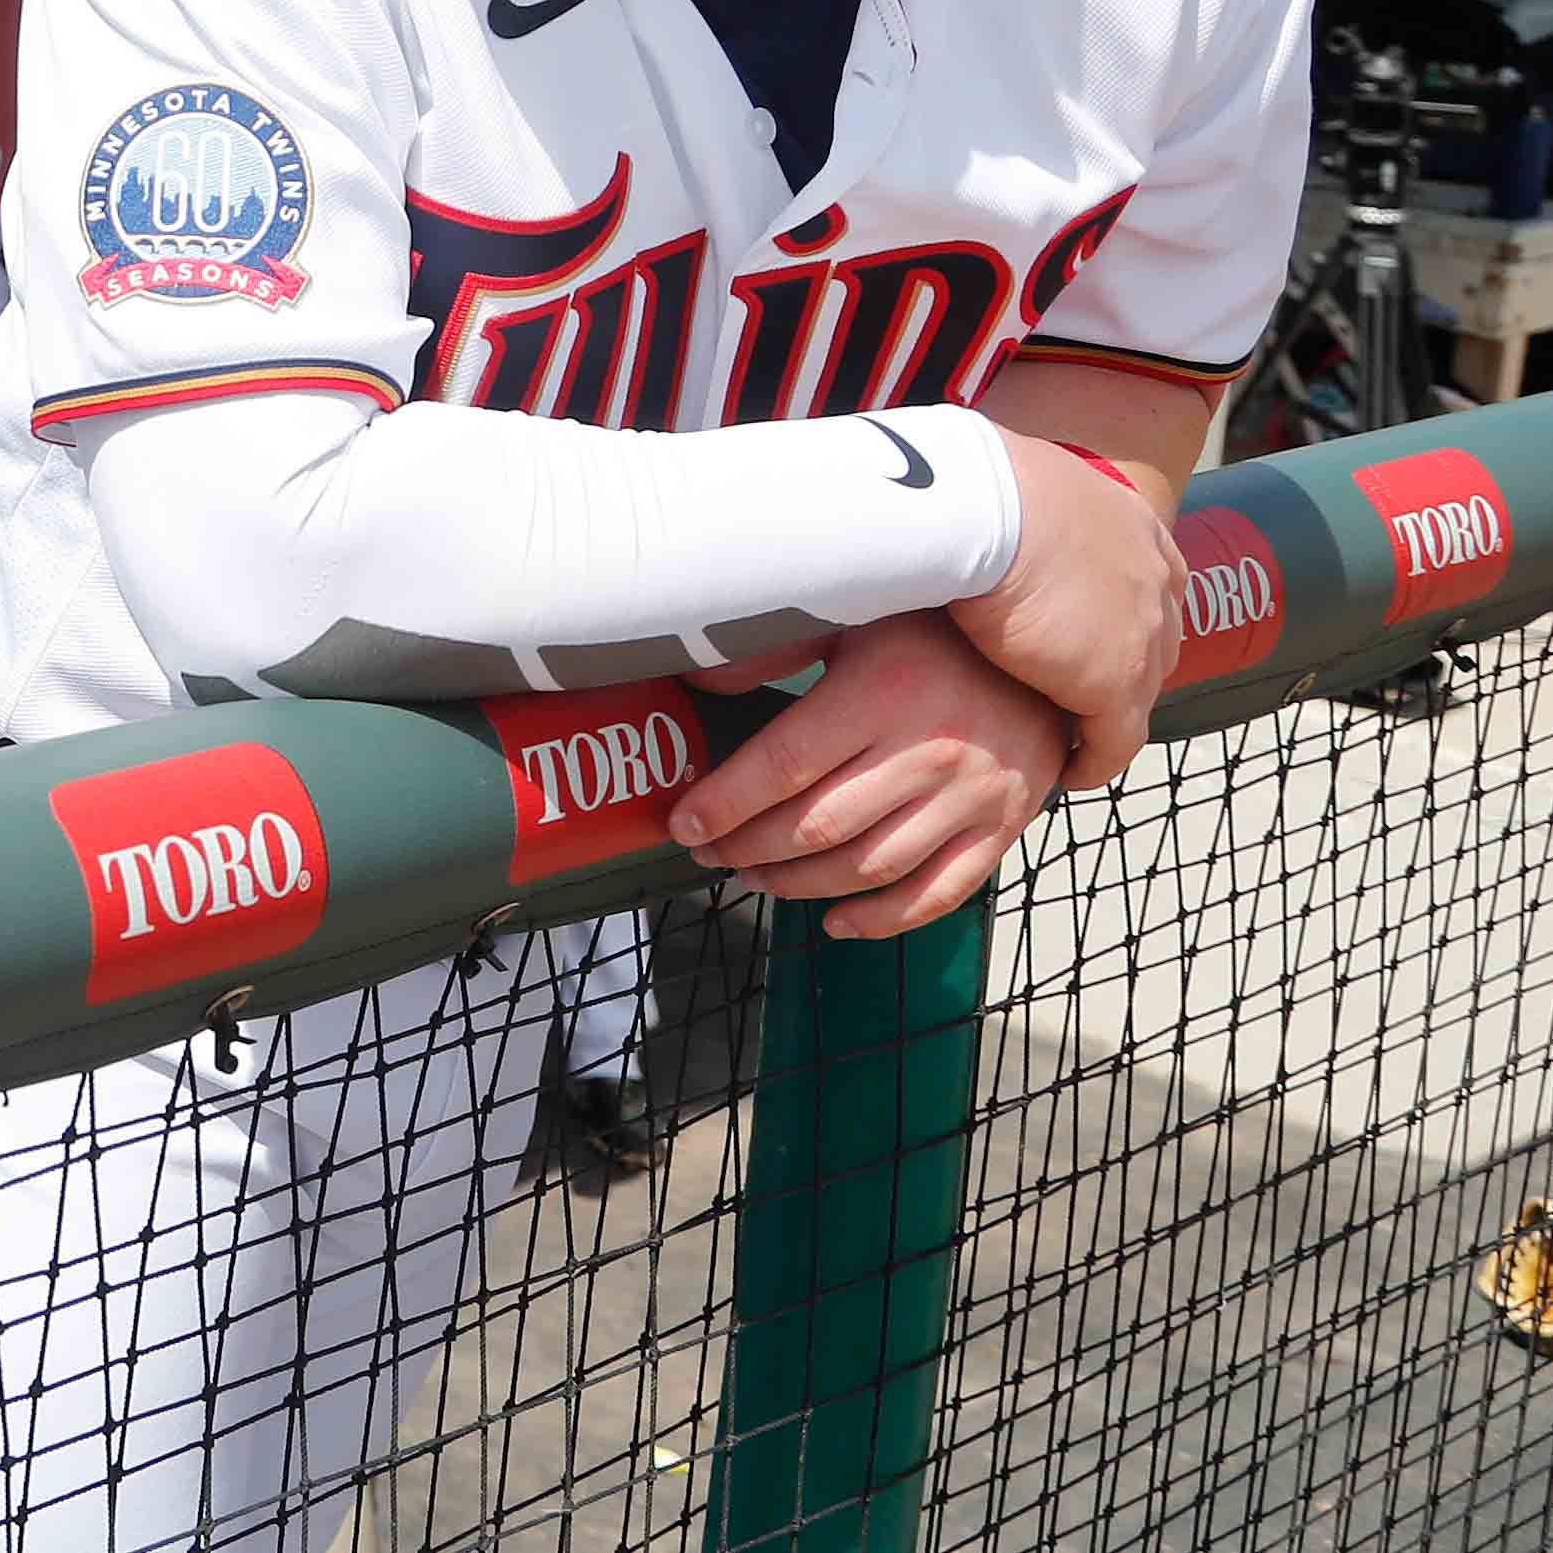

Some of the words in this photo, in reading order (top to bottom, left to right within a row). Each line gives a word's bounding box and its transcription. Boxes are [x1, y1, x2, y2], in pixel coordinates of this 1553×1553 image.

[86, 90, 231, 223] MINNESOTA
[250, 111, 303, 224] TWINS
[106, 263, 275, 297] SEASONS
[1392, 492, 1500, 578] TORO
[519, 709, 687, 825] TORO
[98, 810, 303, 941] TORO
